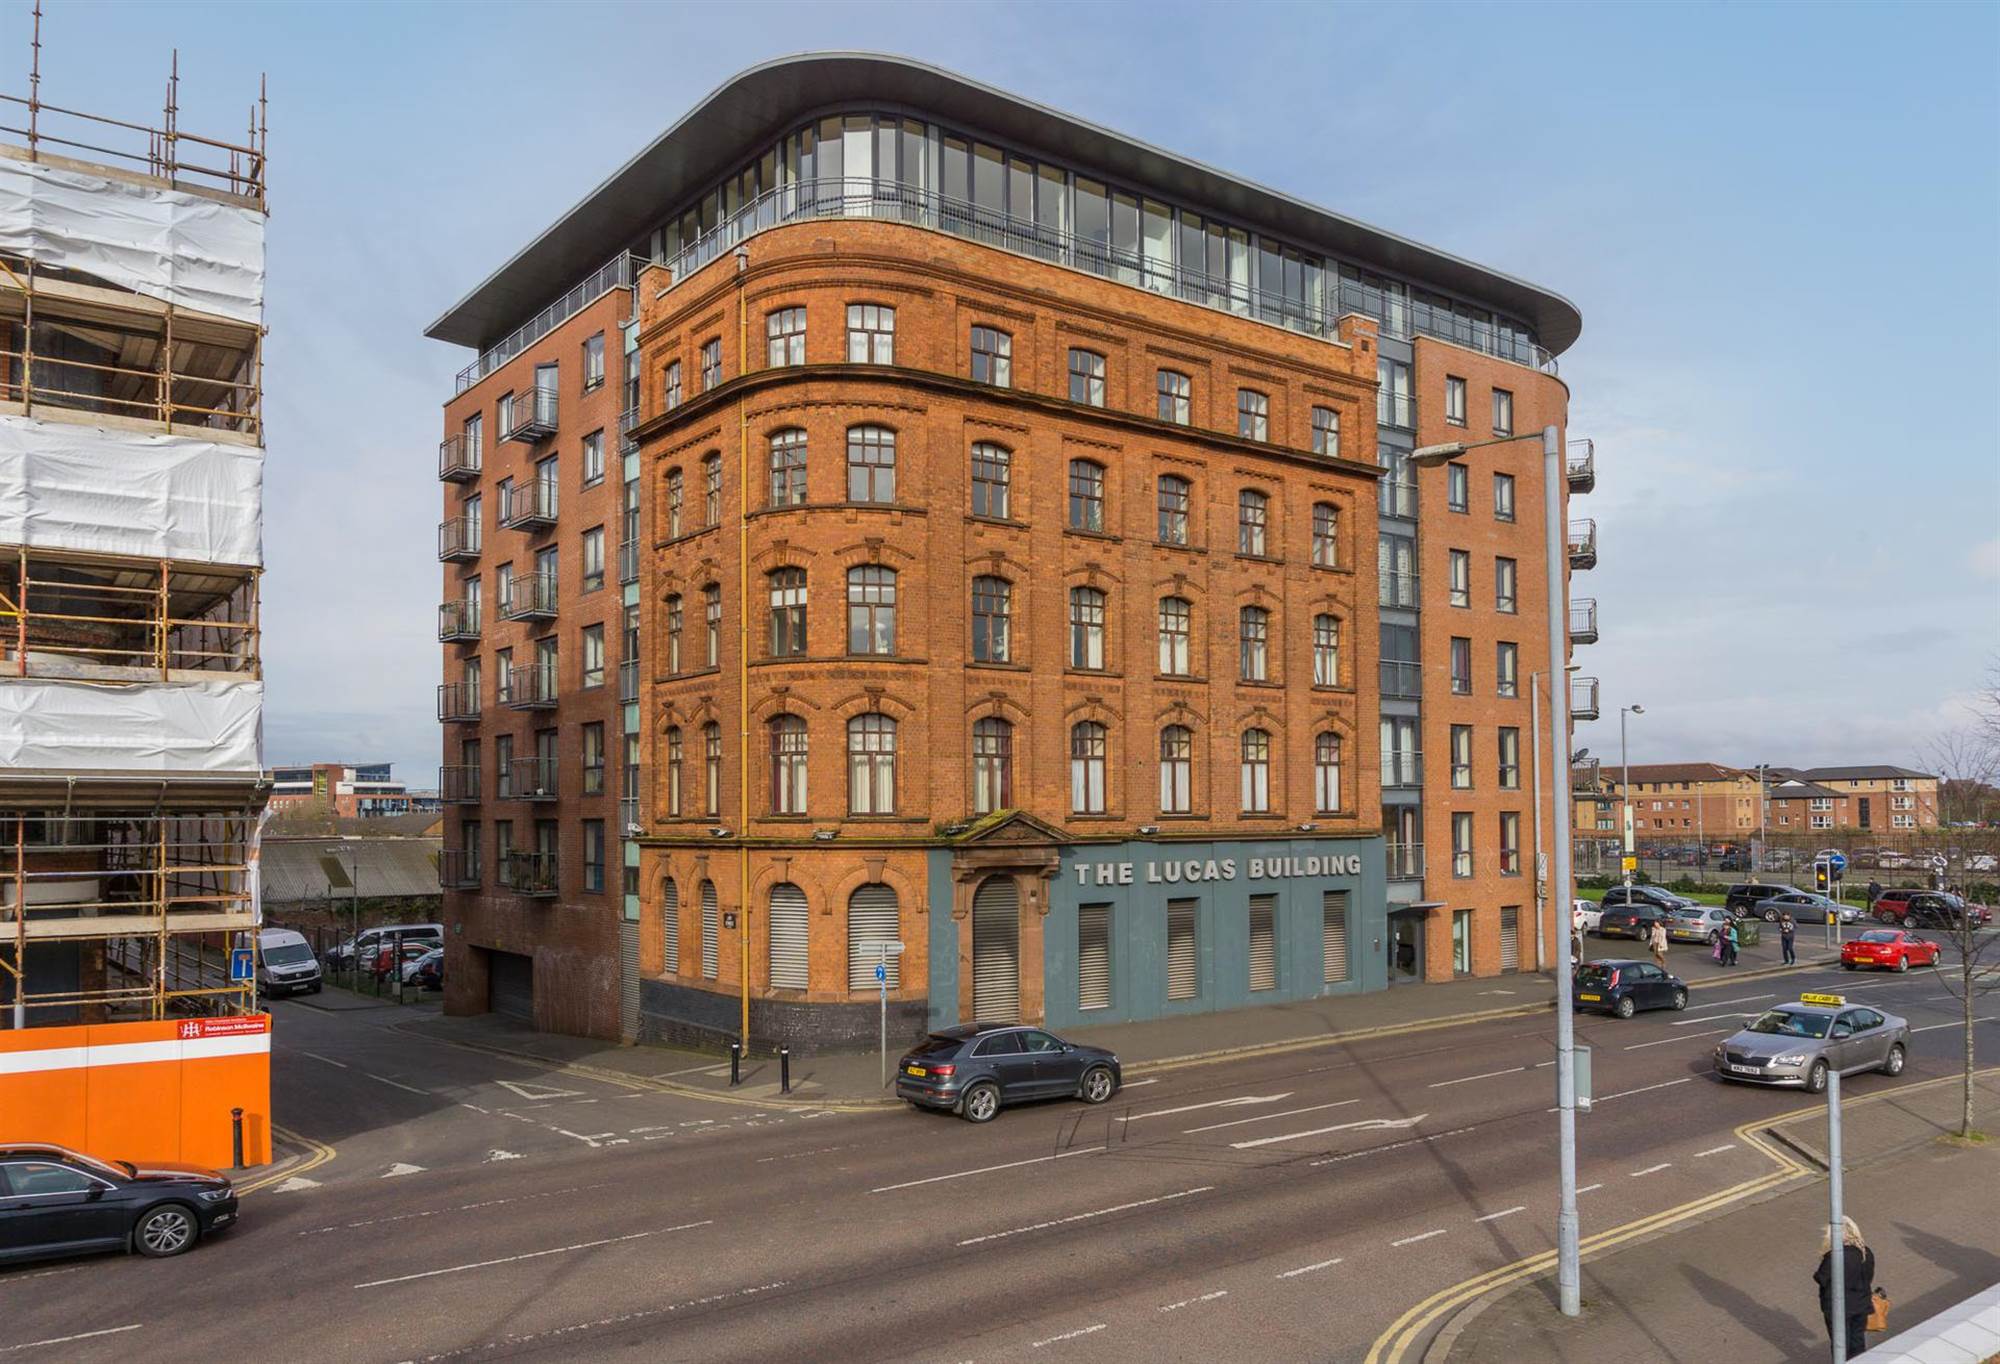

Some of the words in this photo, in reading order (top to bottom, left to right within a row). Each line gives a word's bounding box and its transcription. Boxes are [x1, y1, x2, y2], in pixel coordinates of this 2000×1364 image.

[1074, 862, 1134, 885] THE
[1147, 858, 1237, 883] LUCAS
[1249, 854, 1361, 879] BUILDING
